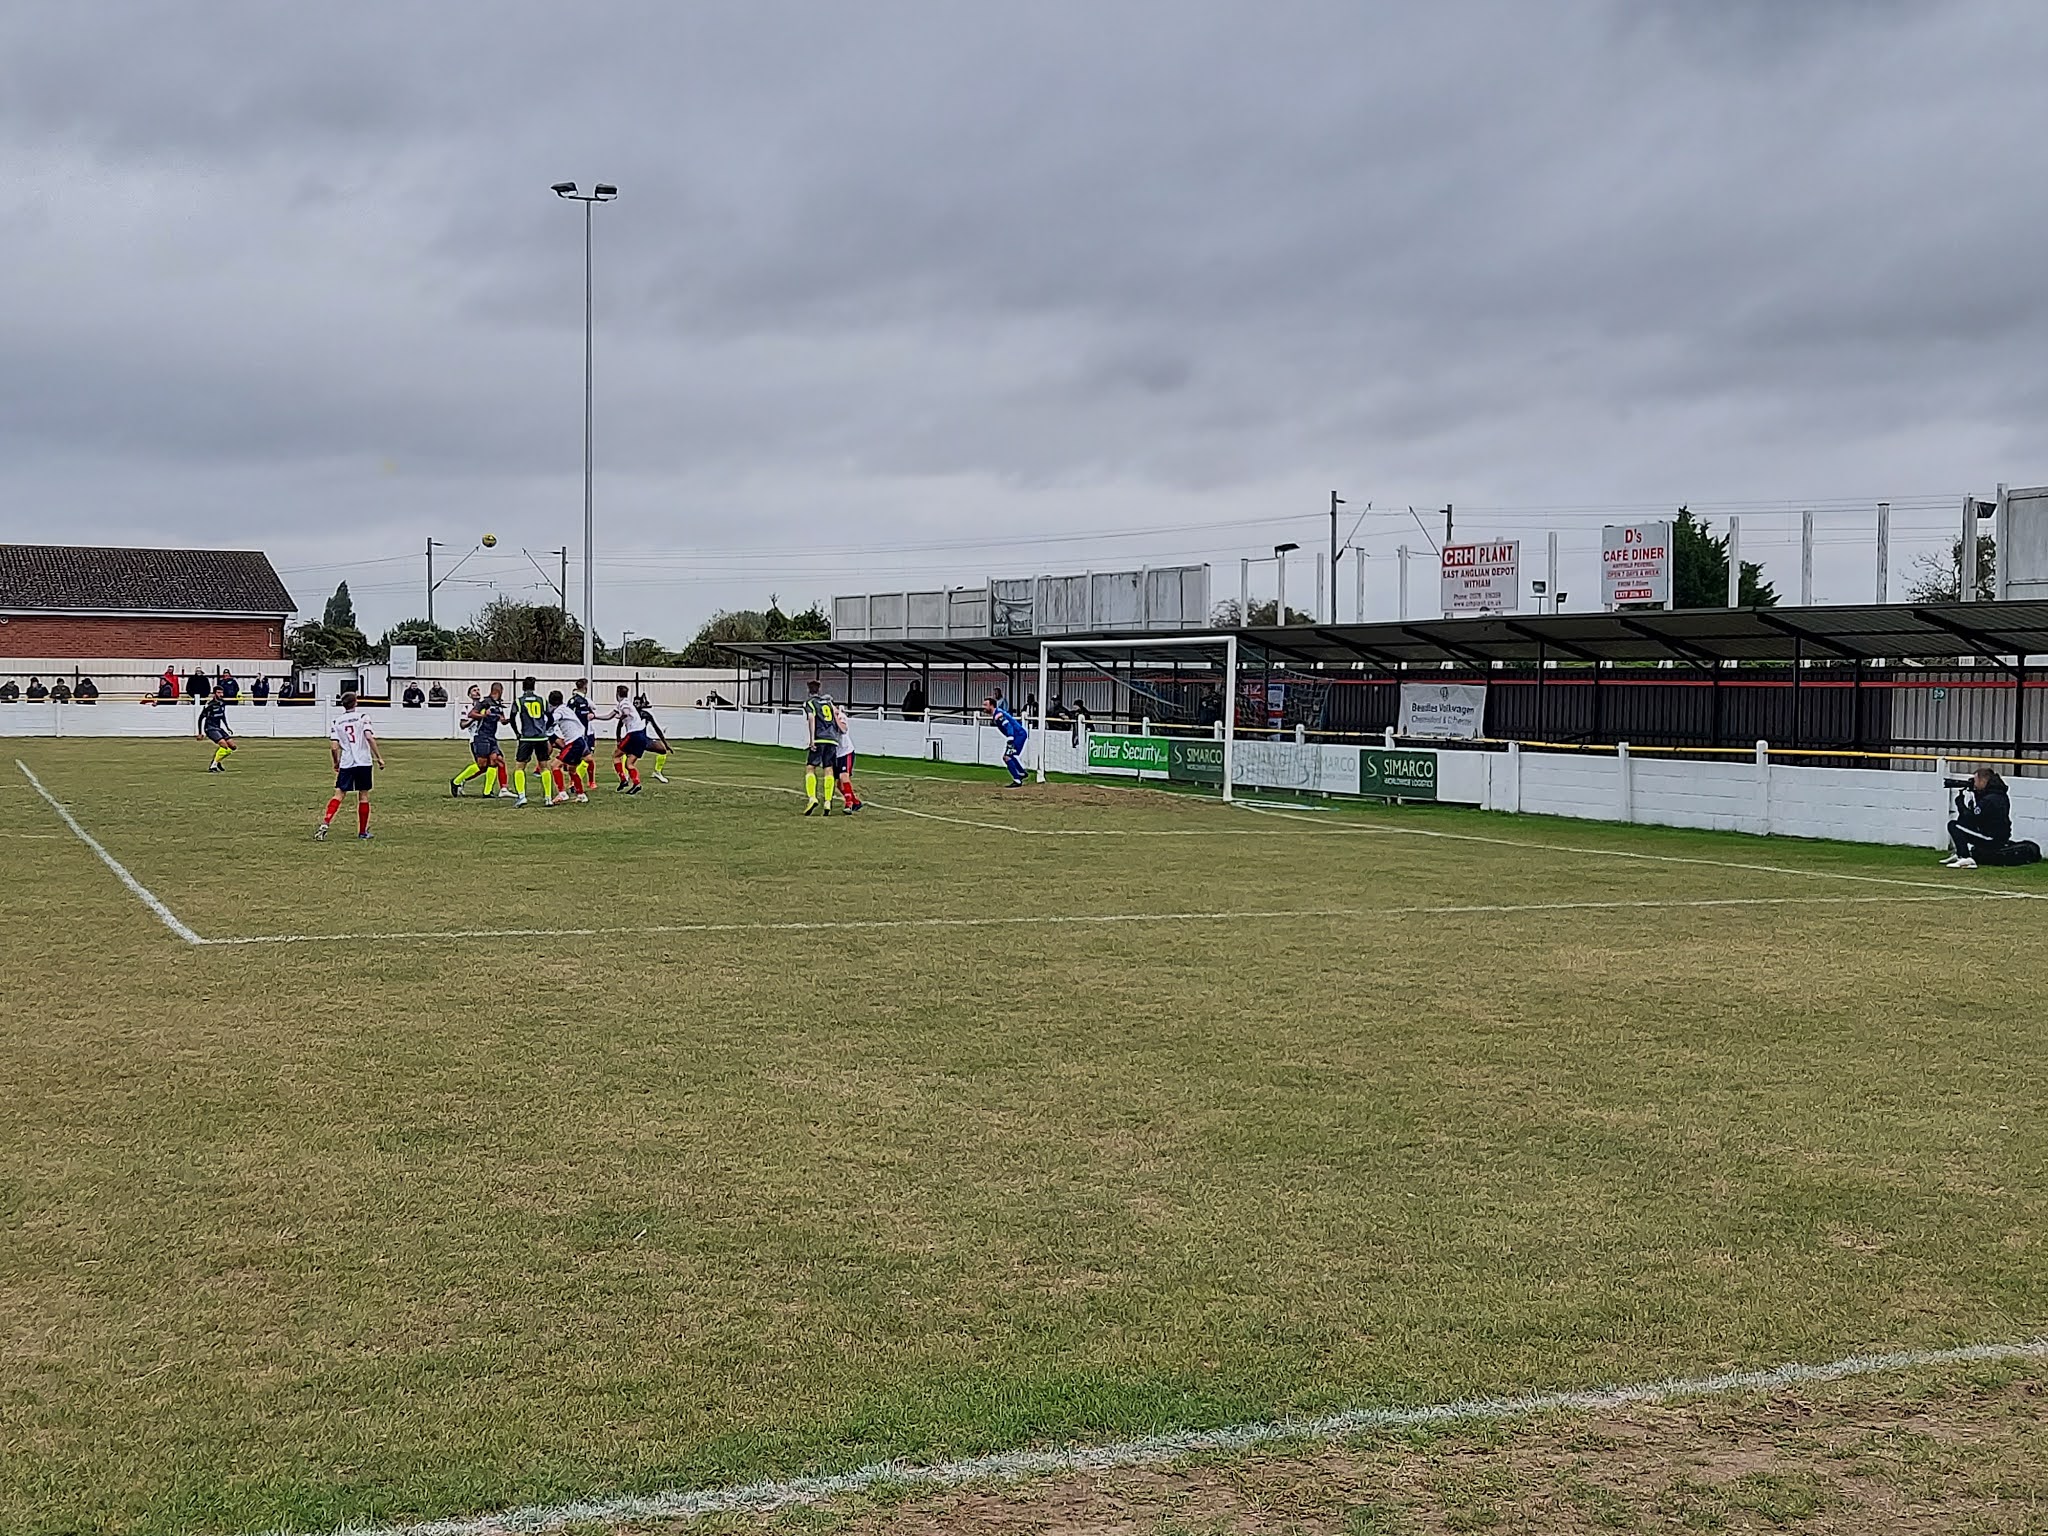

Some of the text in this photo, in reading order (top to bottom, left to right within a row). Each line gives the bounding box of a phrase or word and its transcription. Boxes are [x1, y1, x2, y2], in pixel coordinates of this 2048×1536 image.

[1625, 528, 1642, 543] D's
[1443, 545, 1513, 565] CRH PLANT
[1632, 547, 1664, 560] DINER
[1442, 567, 1515, 578] EAST ANGLIAN DEPOT
[524, 701, 542, 719] 10
[821, 704, 833, 722] 9
[344, 725, 356, 744] 3
[1089, 739, 1161, 765] Panther Security
[1186, 747, 1223, 764] SIMARCO
[1384, 759, 1434, 778] SIMARCO
